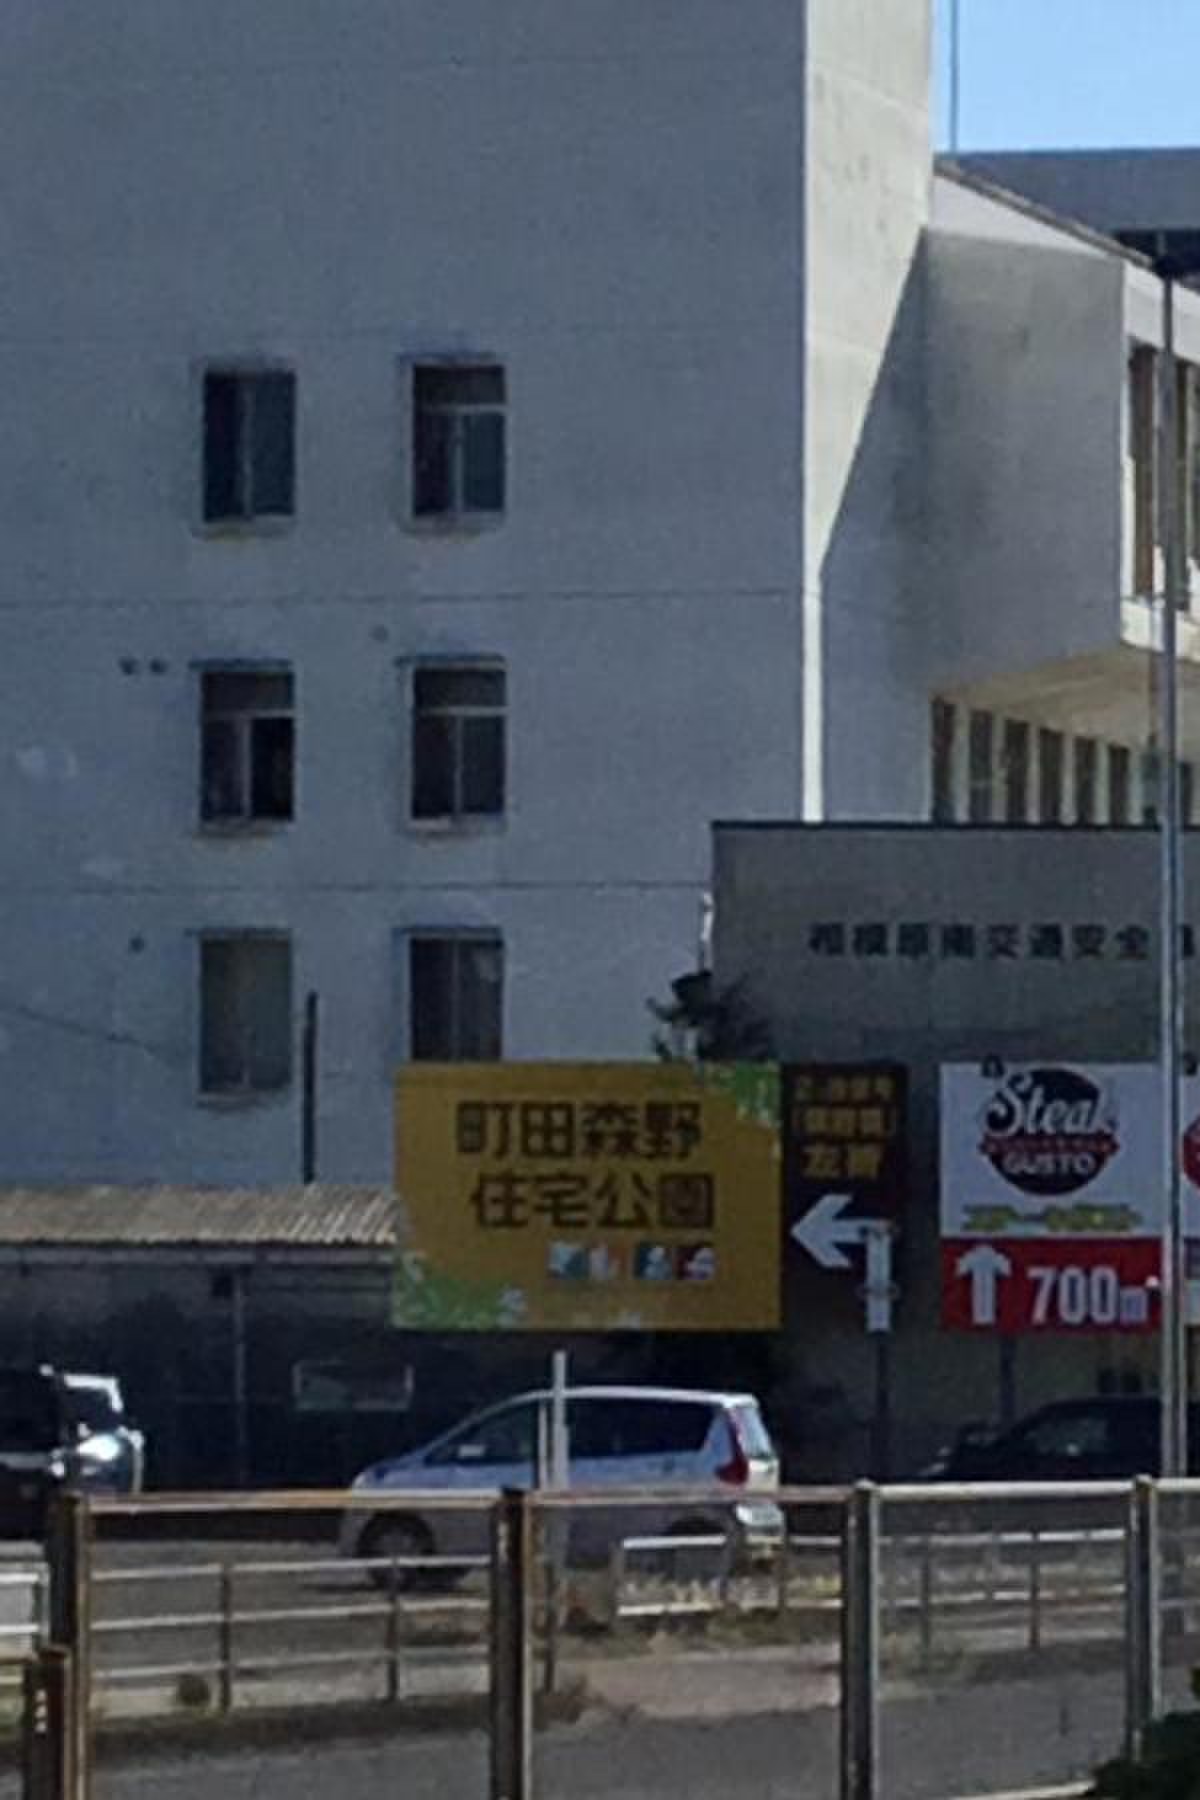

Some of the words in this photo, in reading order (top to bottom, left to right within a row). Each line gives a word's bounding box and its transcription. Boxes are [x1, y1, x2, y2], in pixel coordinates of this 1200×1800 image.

[457, 1102, 701, 1160] 町田森野
[470, 1171, 715, 1229] 住宅公園
[1026, 1265, 1150, 1325] 700m
